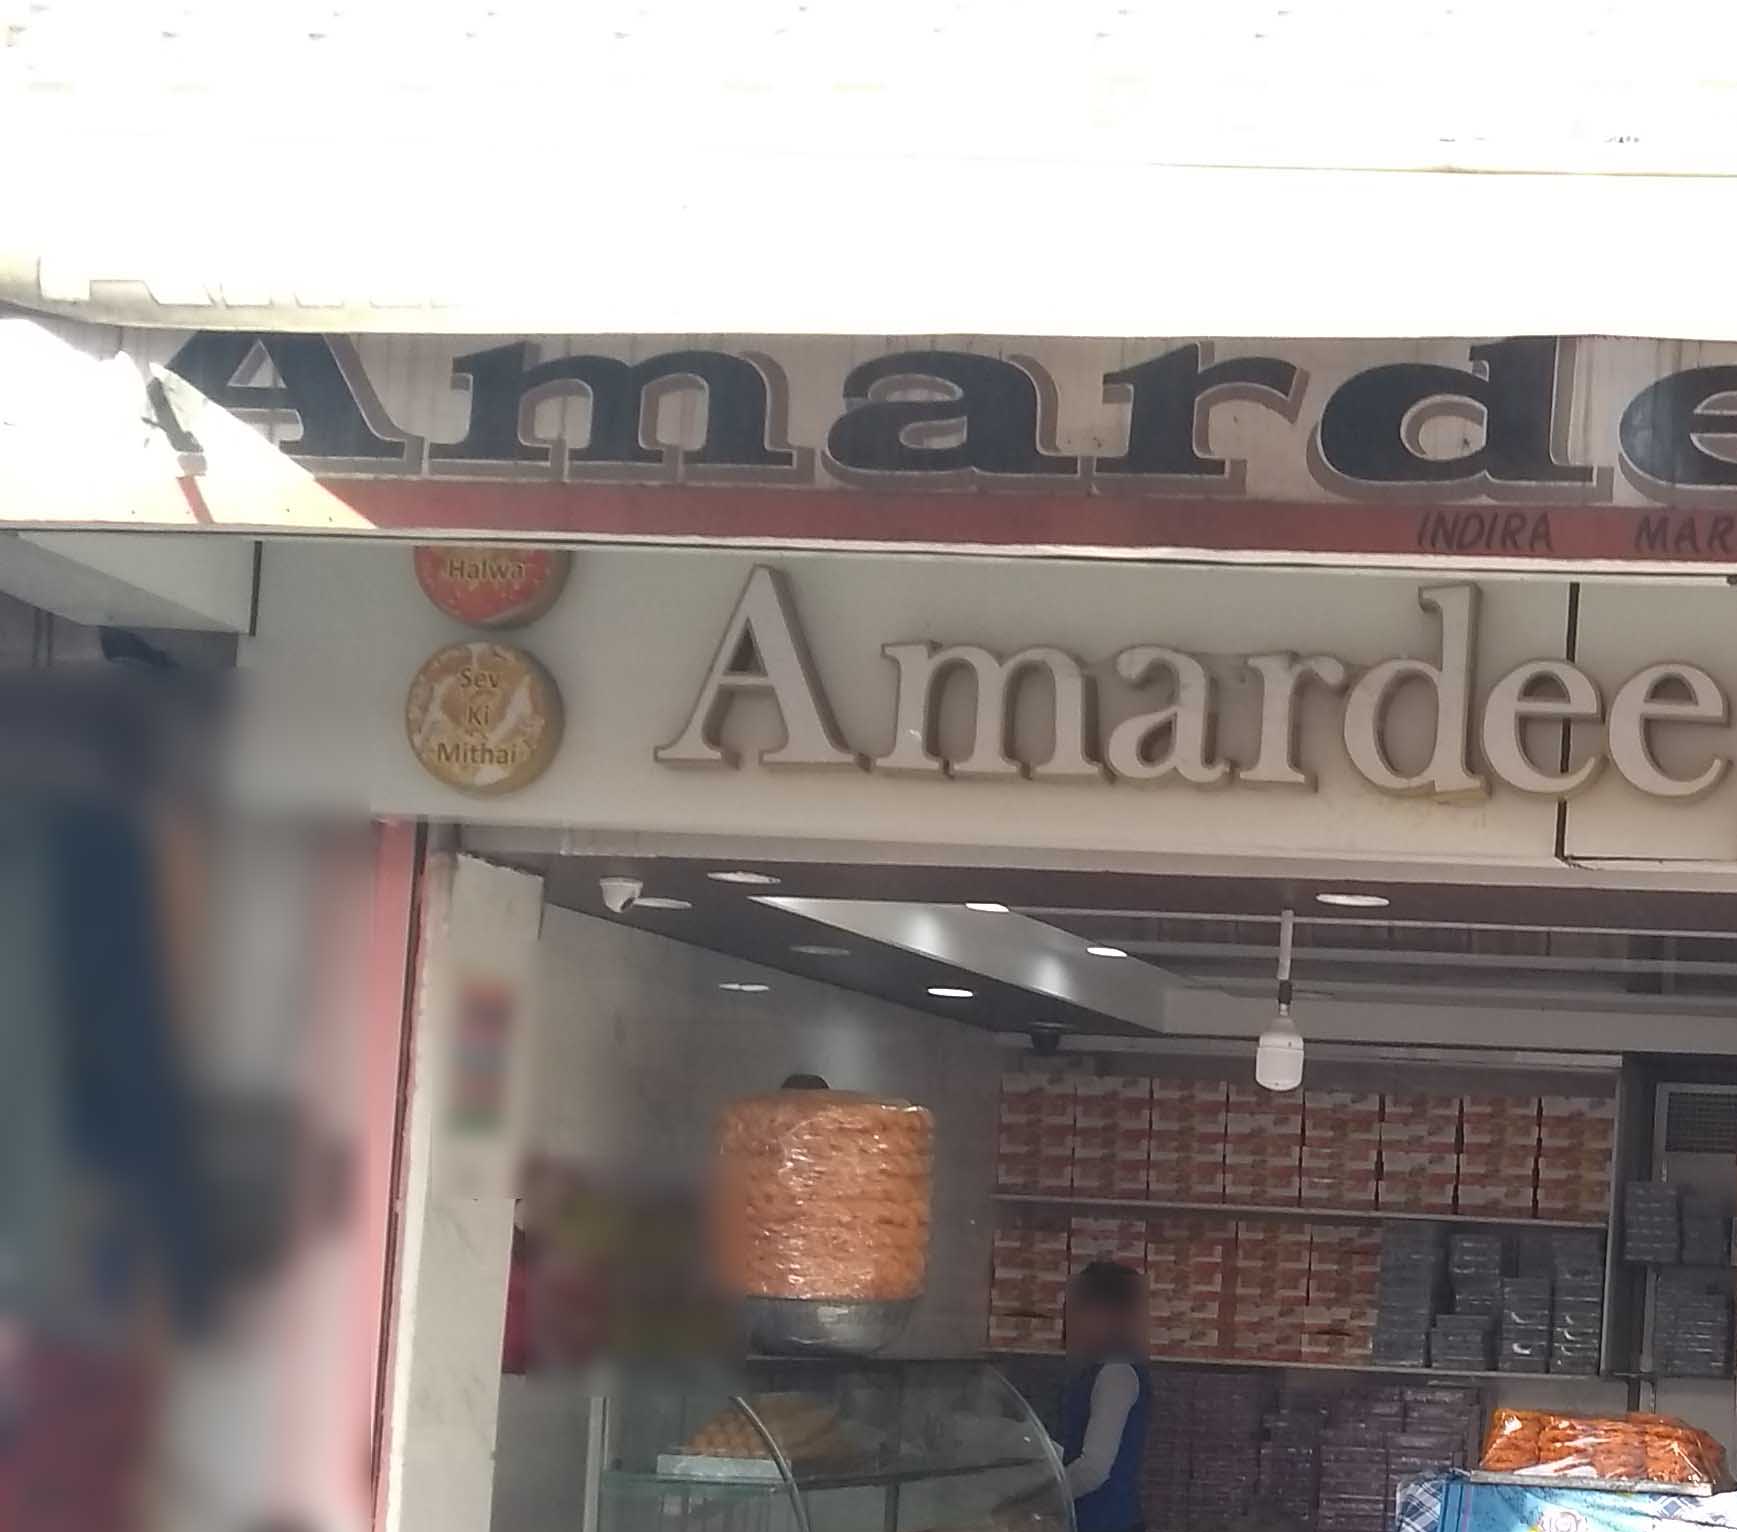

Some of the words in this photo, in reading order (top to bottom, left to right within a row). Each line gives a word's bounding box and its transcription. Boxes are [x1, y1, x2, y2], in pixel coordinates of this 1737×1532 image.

[1416, 509, 1554, 553] INDIRA
[448, 560, 527, 580] Halwa
[459, 667, 501, 689] Sev
[466, 704, 490, 726] Ki
[437, 742, 517, 765] Mithai
